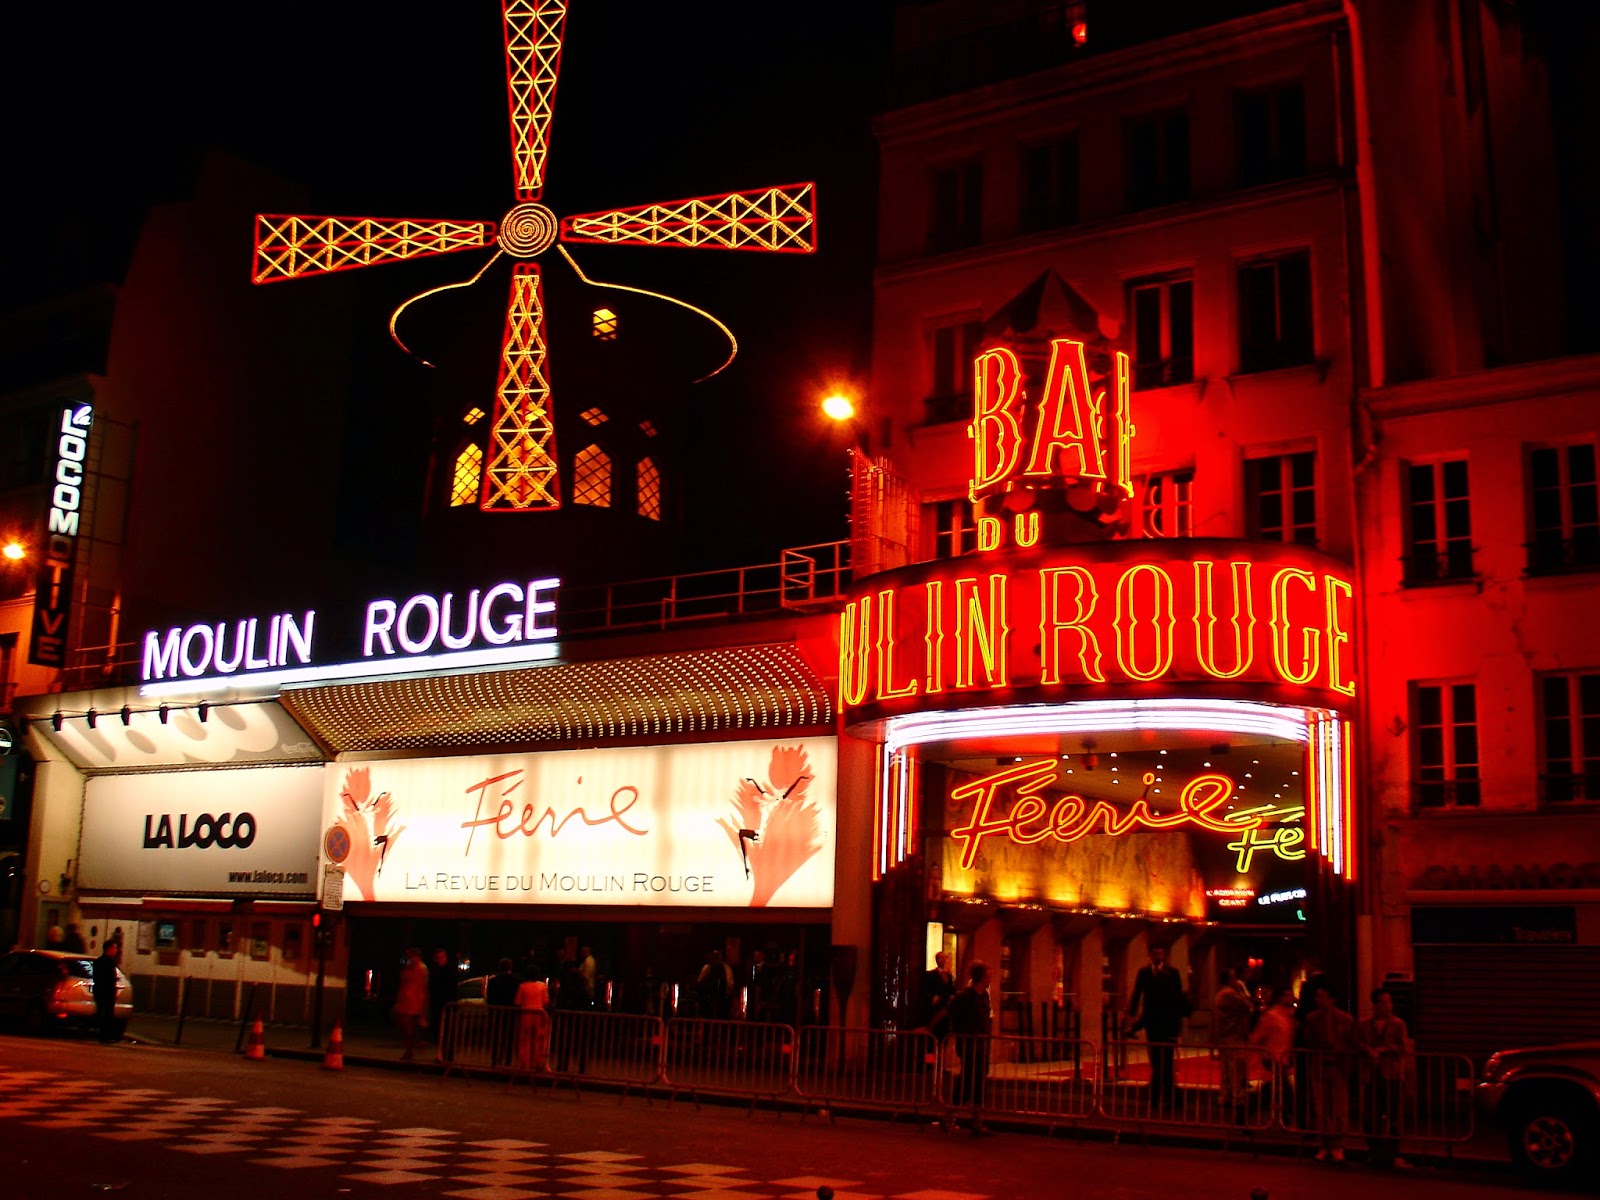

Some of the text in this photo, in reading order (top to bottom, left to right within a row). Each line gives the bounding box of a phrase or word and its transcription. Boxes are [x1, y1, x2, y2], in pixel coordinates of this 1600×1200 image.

[977, 512, 1039, 551] DU
[141, 578, 561, 681] MOULIN ROUGE
[837, 560, 1356, 714] ULIN ROUGE
[143, 811, 257, 849] LA LOCO
[461, 769, 649, 857] Féerie
[950, 758, 1262, 871] Féerie
[228, 869, 309, 883] www.laloco.com
[405, 872, 714, 893] LA REVUE DU MOULIN ROUGE
